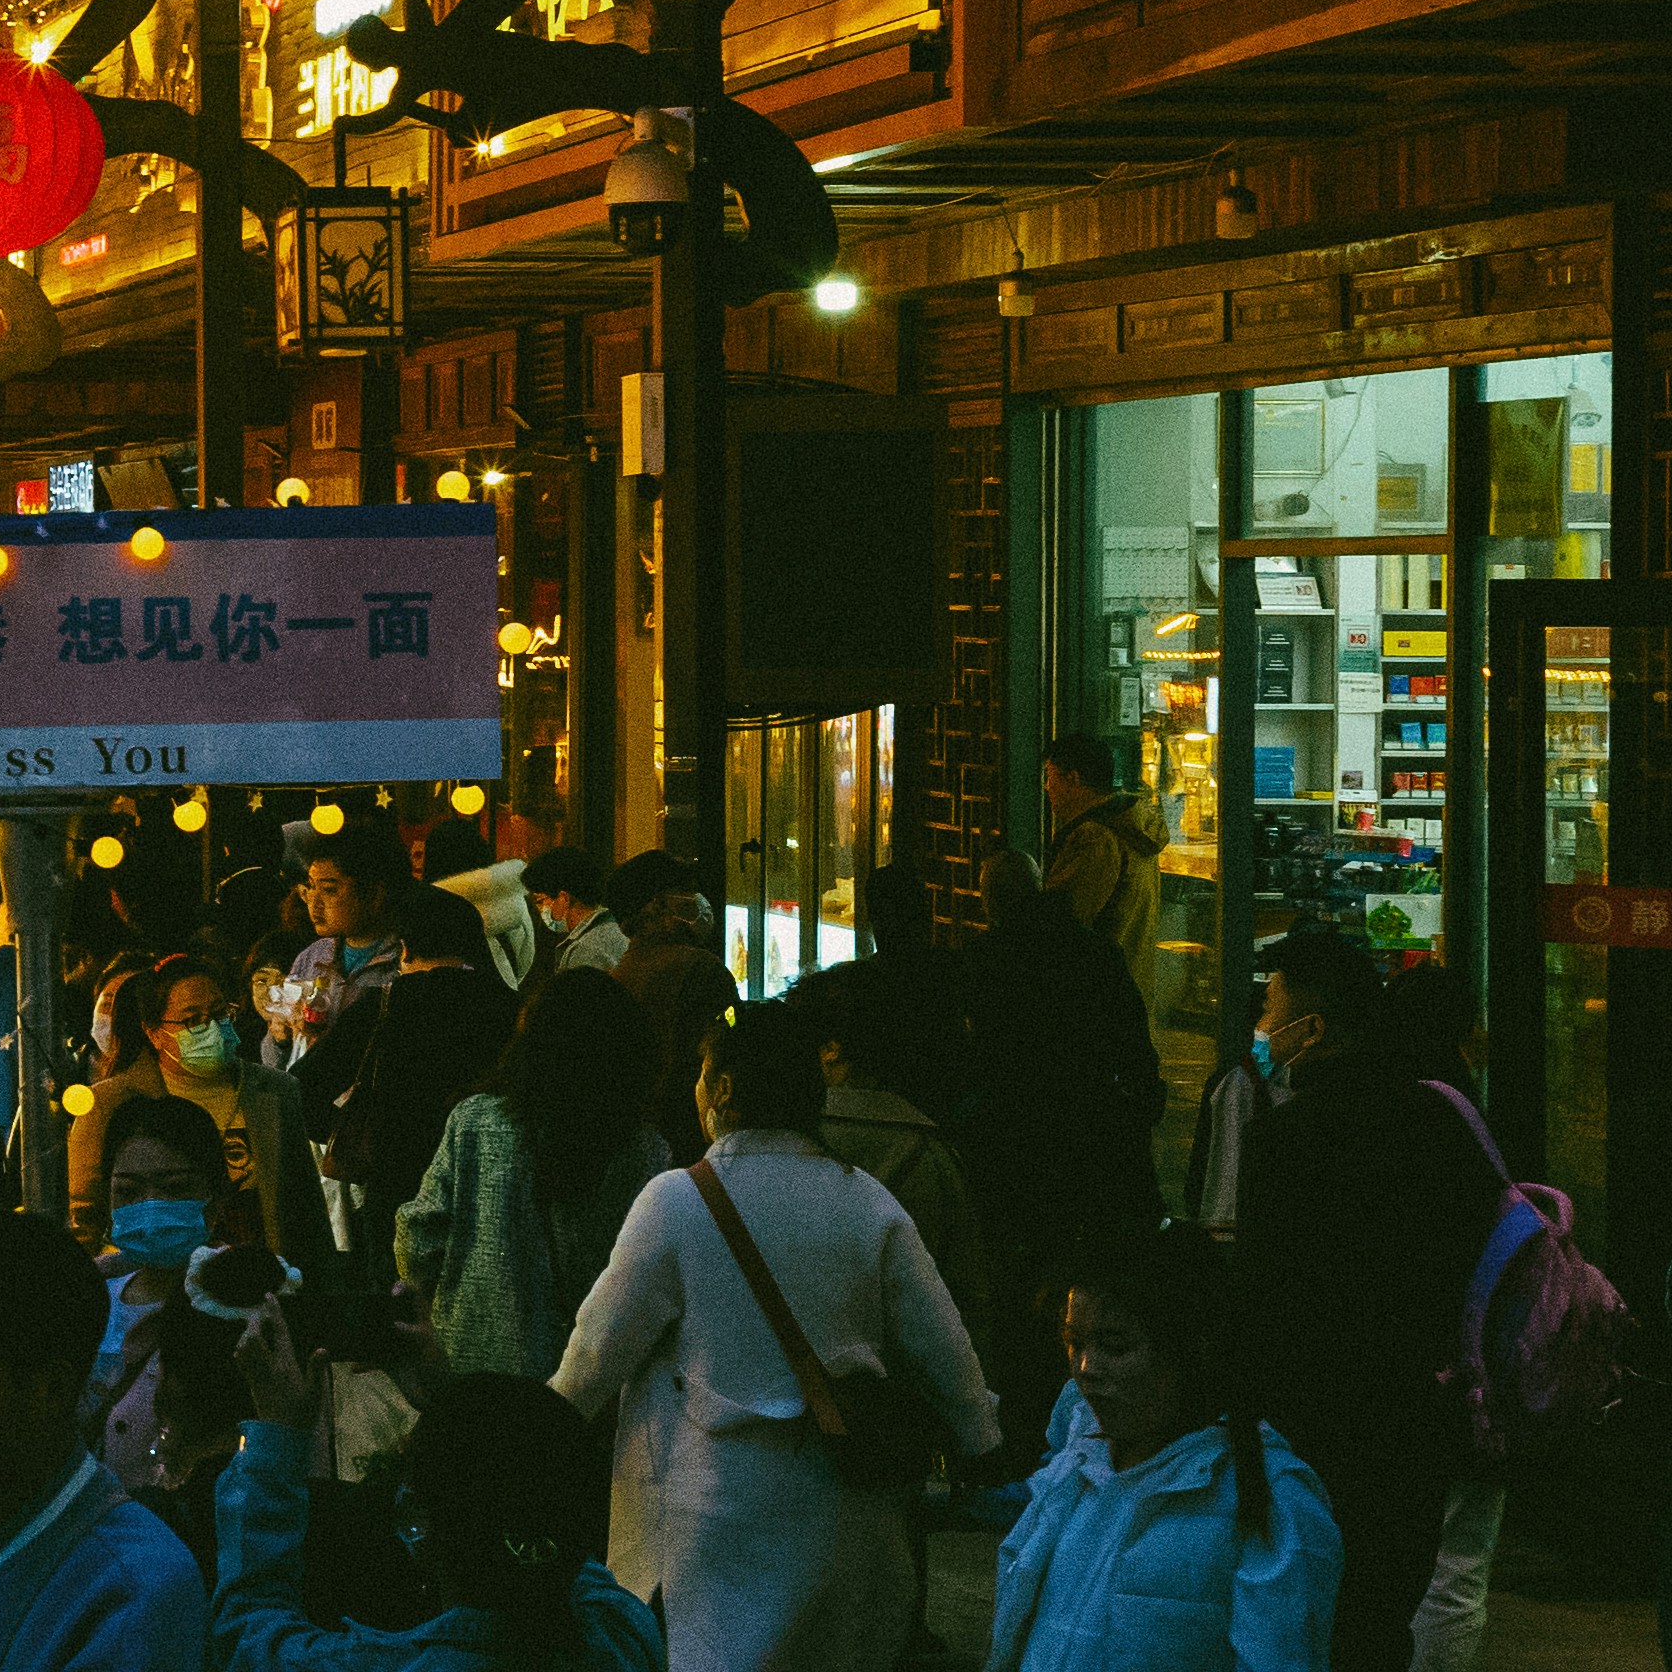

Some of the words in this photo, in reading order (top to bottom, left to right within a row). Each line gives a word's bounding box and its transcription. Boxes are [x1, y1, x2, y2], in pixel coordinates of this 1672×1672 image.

[58, 591, 433, 665] 想见你一面
[93, 735, 188, 775] You
